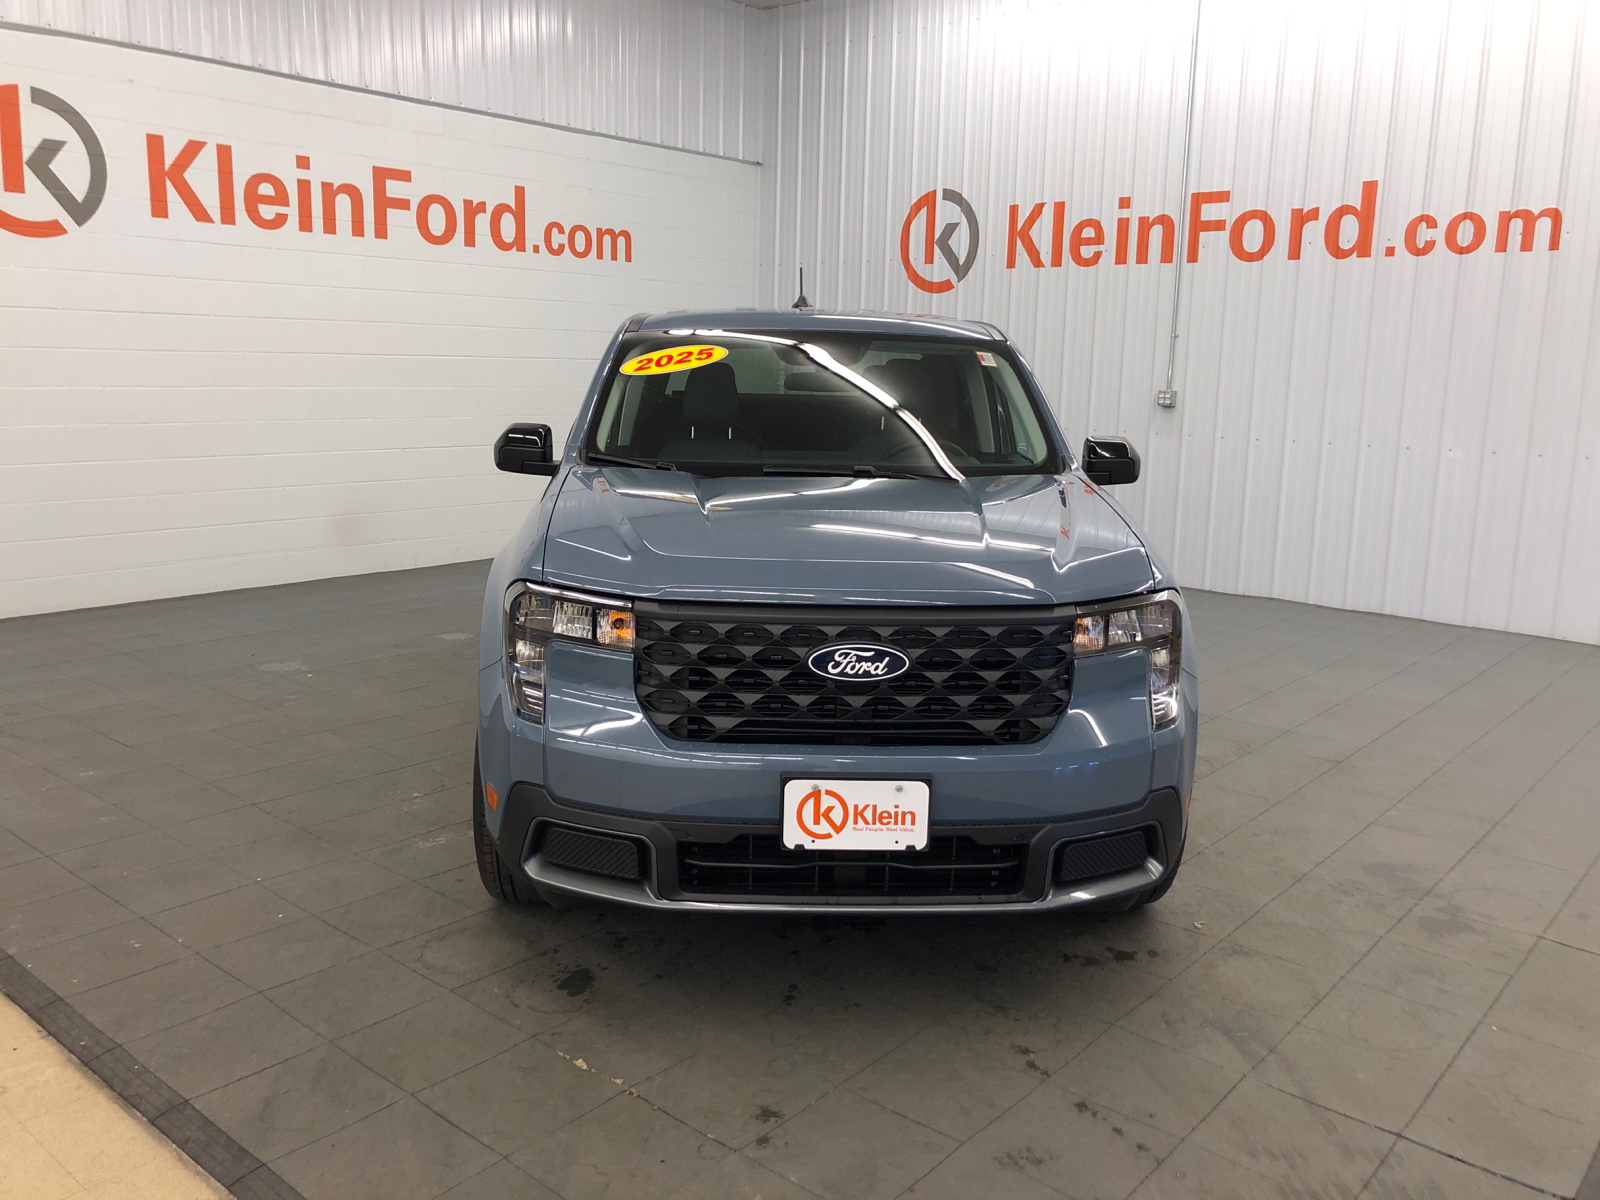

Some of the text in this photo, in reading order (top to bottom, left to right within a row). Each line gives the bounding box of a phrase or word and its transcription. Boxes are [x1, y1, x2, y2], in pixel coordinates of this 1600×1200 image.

[147, 133, 633, 263] KleinFord.com
[1007, 180, 1564, 269] KleinFord.com
[633, 347, 715, 372] 2025
[827, 649, 890, 675] Ford
[853, 804, 916, 826] Klein
